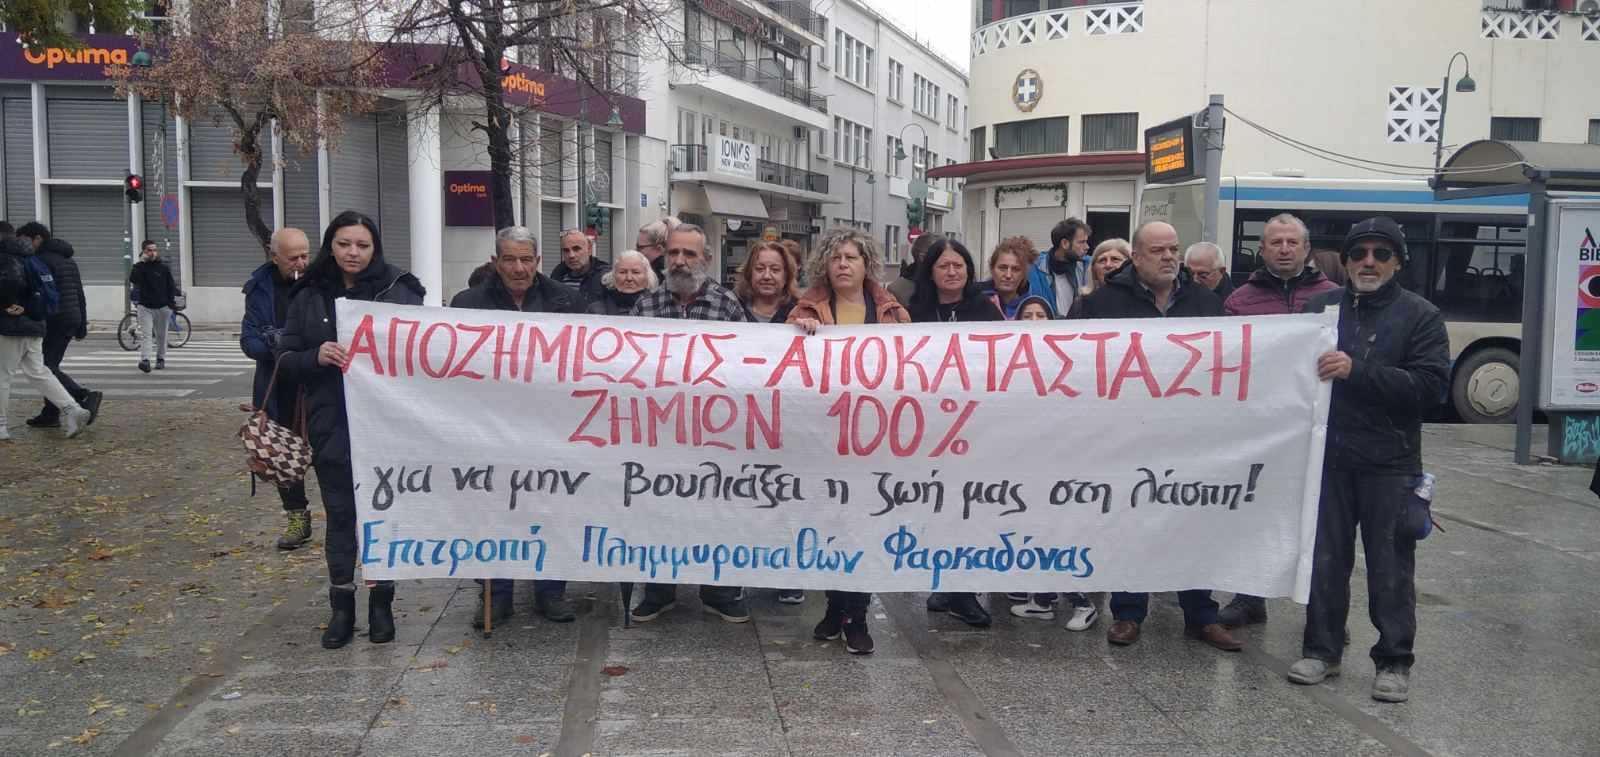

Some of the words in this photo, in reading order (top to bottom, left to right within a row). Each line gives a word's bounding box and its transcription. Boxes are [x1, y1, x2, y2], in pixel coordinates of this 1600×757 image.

[450, 183, 486, 195] Optima
[341, 314, 737, 389] ΑΠΟΖΗΜΙΩΣΕΙΣ
[765, 323, 1252, 402] ΑΠΟΚΑΤΑΣΤΑΣΗ
[567, 388, 783, 451] ΖΗΜΙΩΝ
[826, 390, 979, 459] 100%
[371, 465, 433, 511] για
[452, 464, 495, 493] να
[509, 467, 591, 510] μην
[824, 478, 849, 505] η
[870, 468, 945, 517] ζωή
[962, 478, 1028, 521] μας
[1049, 478, 1113, 514] στη
[1130, 463, 1265, 511] λάσπη!
[360, 519, 548, 577] Επιτροπή
[581, 525, 864, 581] Πλημμυροπαθών
[882, 524, 1095, 590] Φαρκαδόνας
